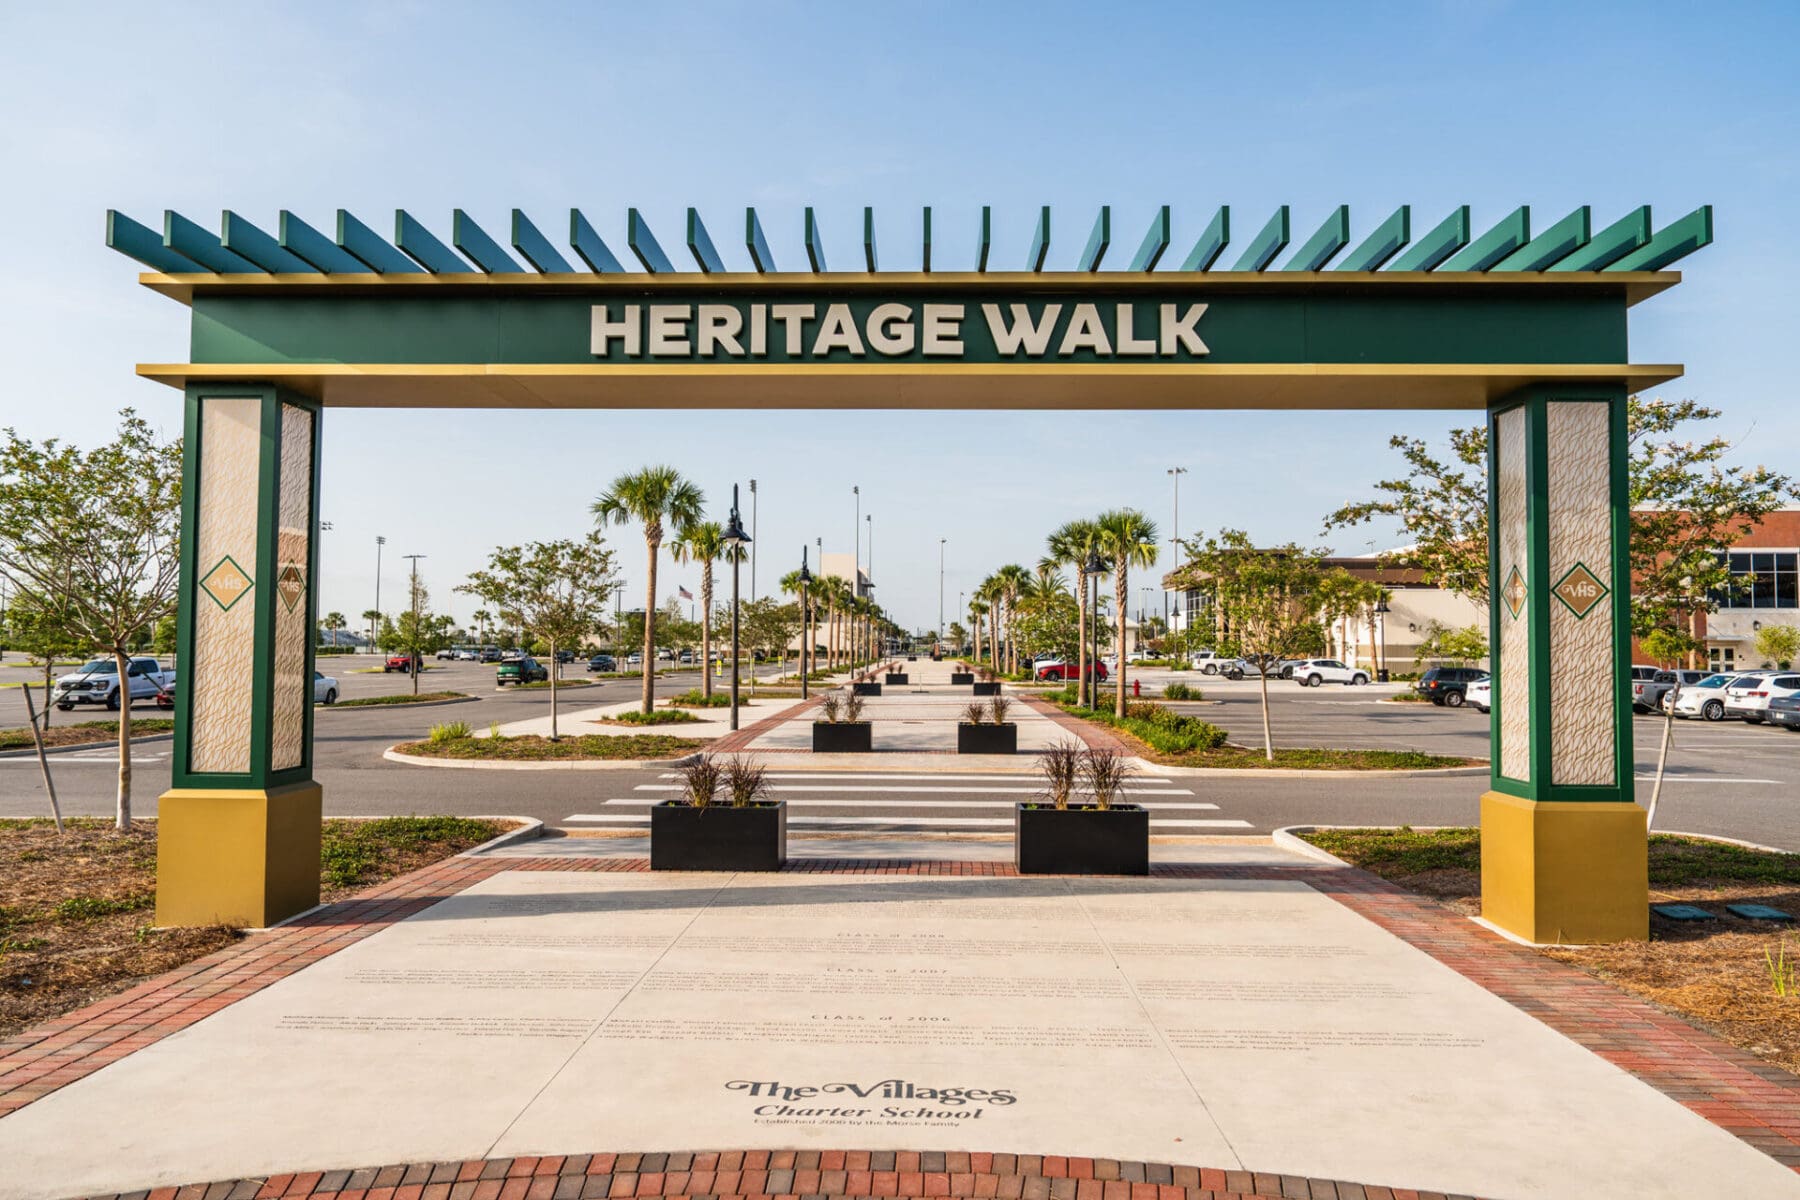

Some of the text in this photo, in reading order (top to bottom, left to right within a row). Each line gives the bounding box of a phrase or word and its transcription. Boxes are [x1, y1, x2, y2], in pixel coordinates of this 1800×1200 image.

[590, 303, 1209, 356] HERITAGE WALK
[724, 1079, 1017, 1105] The Villages
[753, 1105, 984, 1119] Charter School
